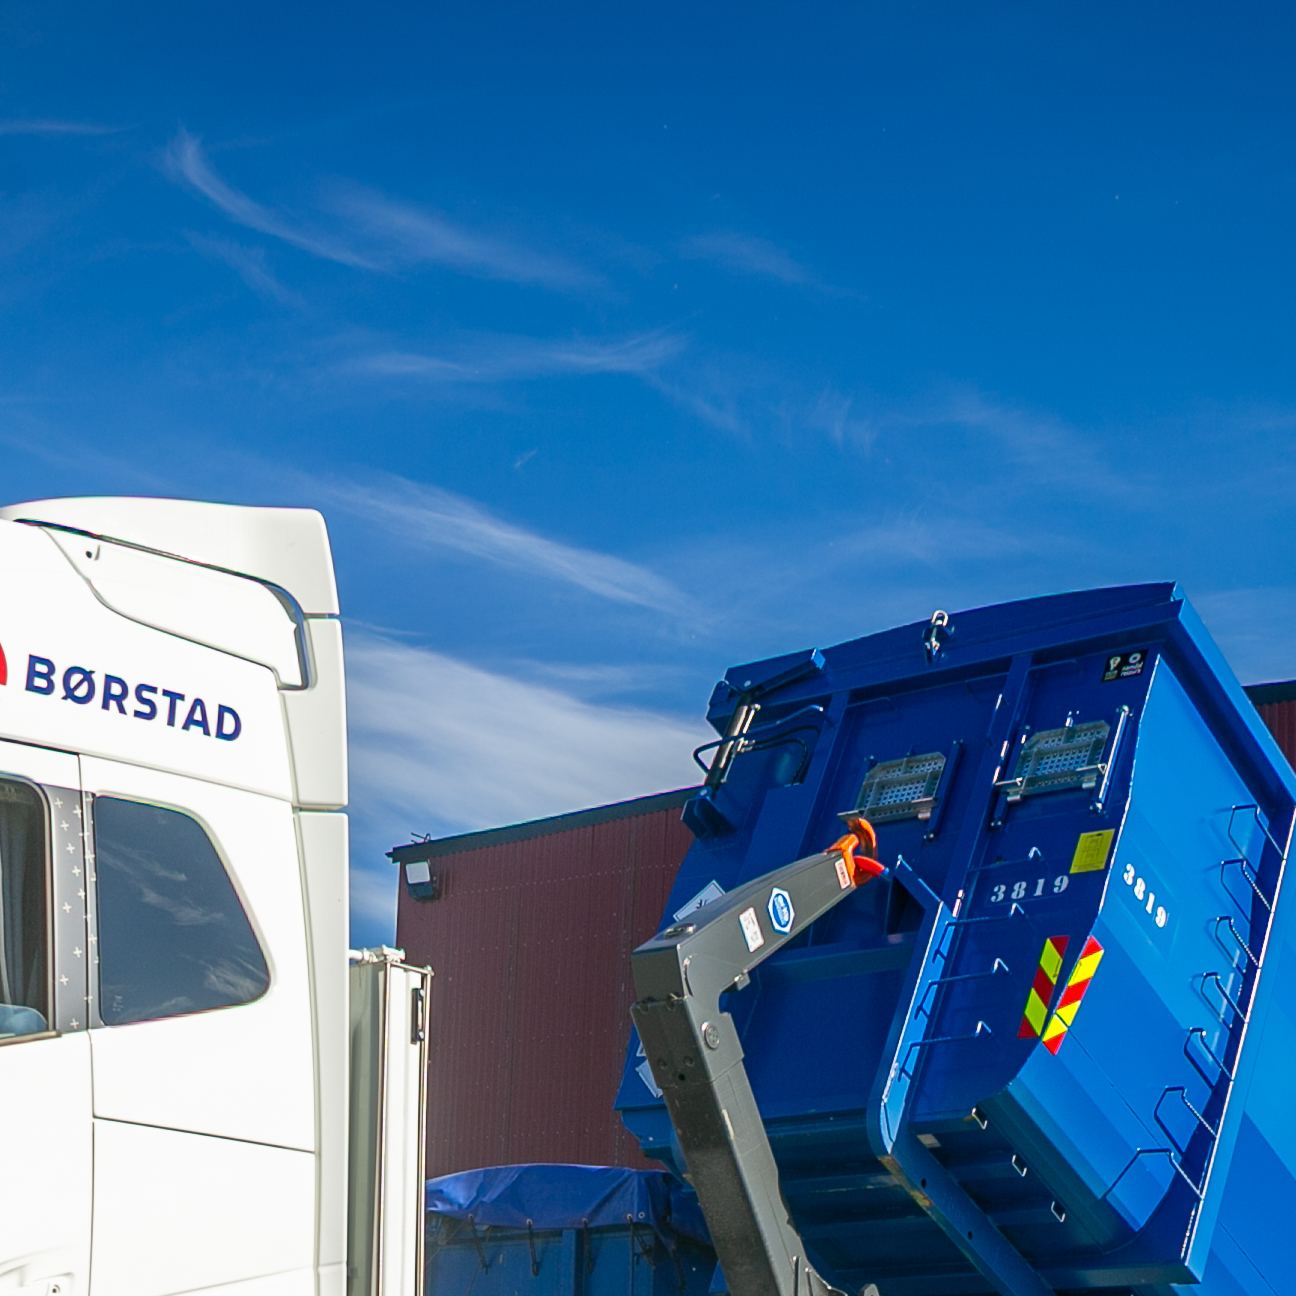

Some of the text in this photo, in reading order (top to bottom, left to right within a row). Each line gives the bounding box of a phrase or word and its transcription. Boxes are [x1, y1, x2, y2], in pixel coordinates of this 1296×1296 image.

[25, 654, 242, 741] BØRSTAD
[990, 874, 1070, 903] 3819
[1122, 863, 1169, 928] 3819
